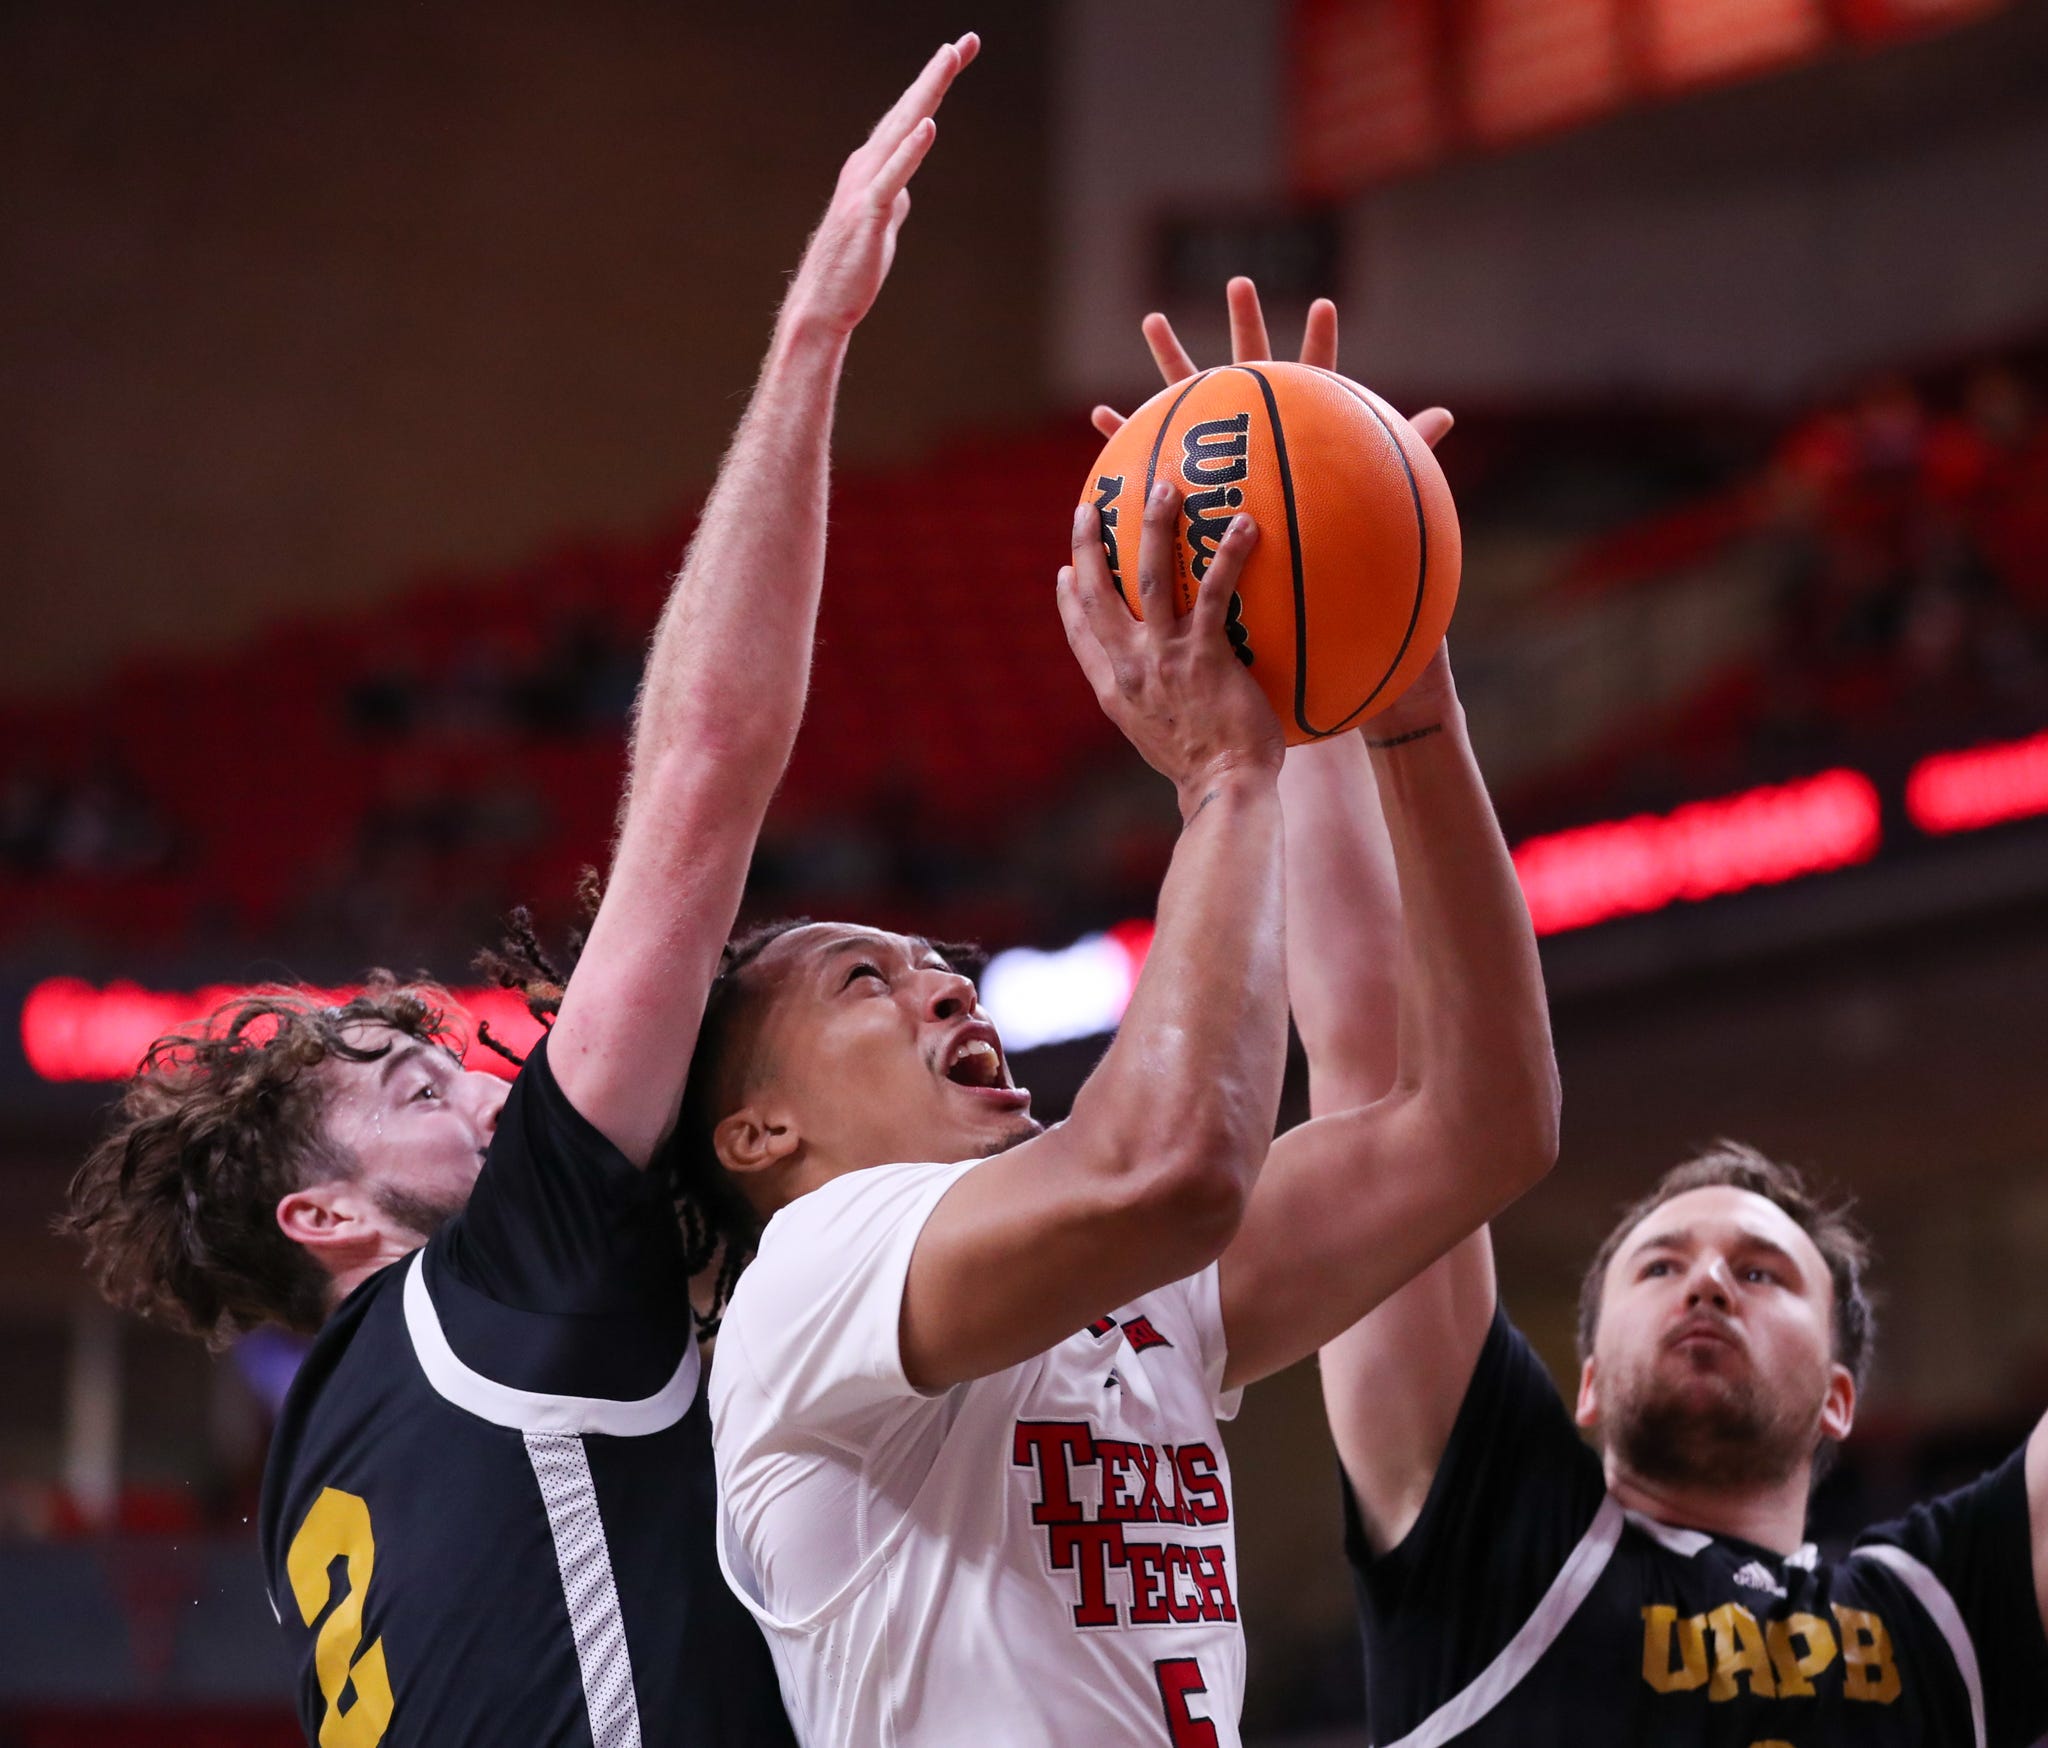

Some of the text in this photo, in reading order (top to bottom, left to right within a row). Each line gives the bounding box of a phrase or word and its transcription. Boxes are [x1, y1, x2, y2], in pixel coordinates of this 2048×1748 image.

[286, 1486, 395, 1748] 2
[1049, 1521, 1238, 1628] TECH
[1640, 1601, 1902, 1704] UAPB
